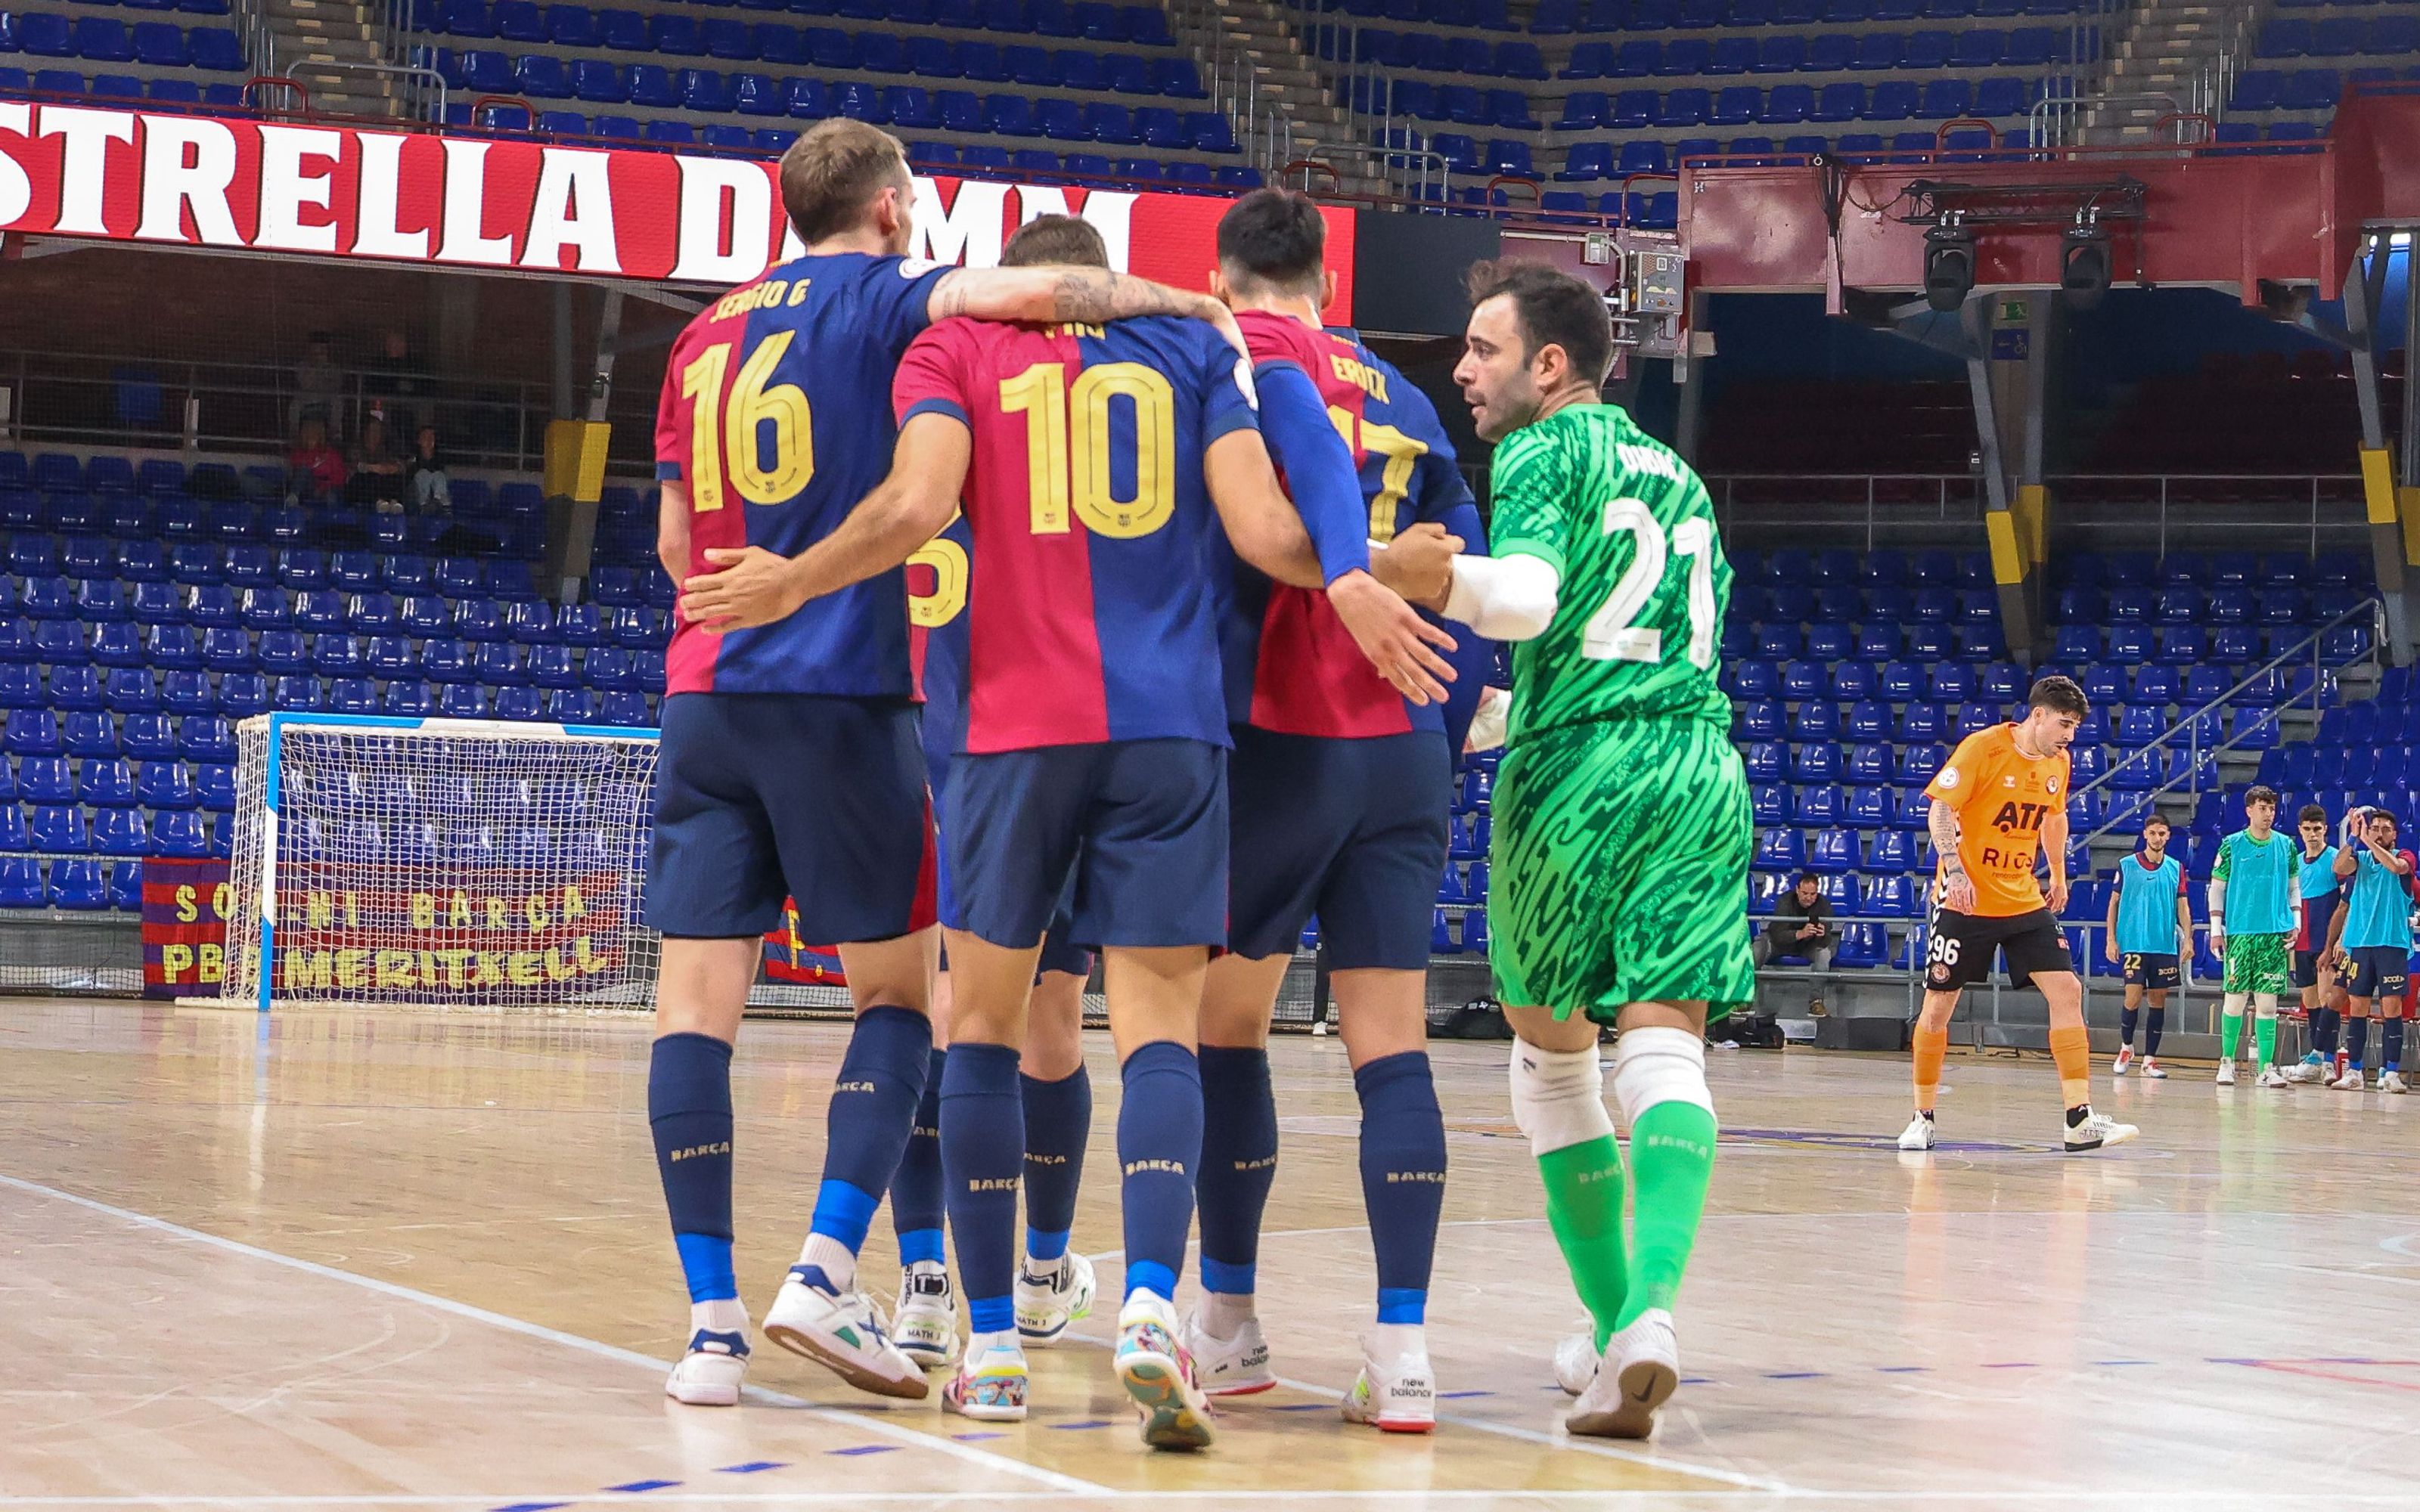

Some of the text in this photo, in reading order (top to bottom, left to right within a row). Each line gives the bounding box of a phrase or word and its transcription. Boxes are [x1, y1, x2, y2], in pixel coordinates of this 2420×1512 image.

[674, 155, 1140, 283] DMM
[709, 278, 811, 324] SERGIO G
[1329, 353, 1390, 405] ERICK
[683, 330, 814, 512] 16
[999, 362, 1174, 538] 10
[1581, 497, 1714, 670] 21
[413, 885, 585, 934] BARÇA
[1931, 934, 1960, 965] 96
[2124, 953, 2142, 970] 22
[2229, 957, 2235, 976] 1
[671, 1141, 730, 1162] BARÇA
[1023, 1152, 1066, 1165] ARÇA
[1402, 1378, 1425, 1388] new
